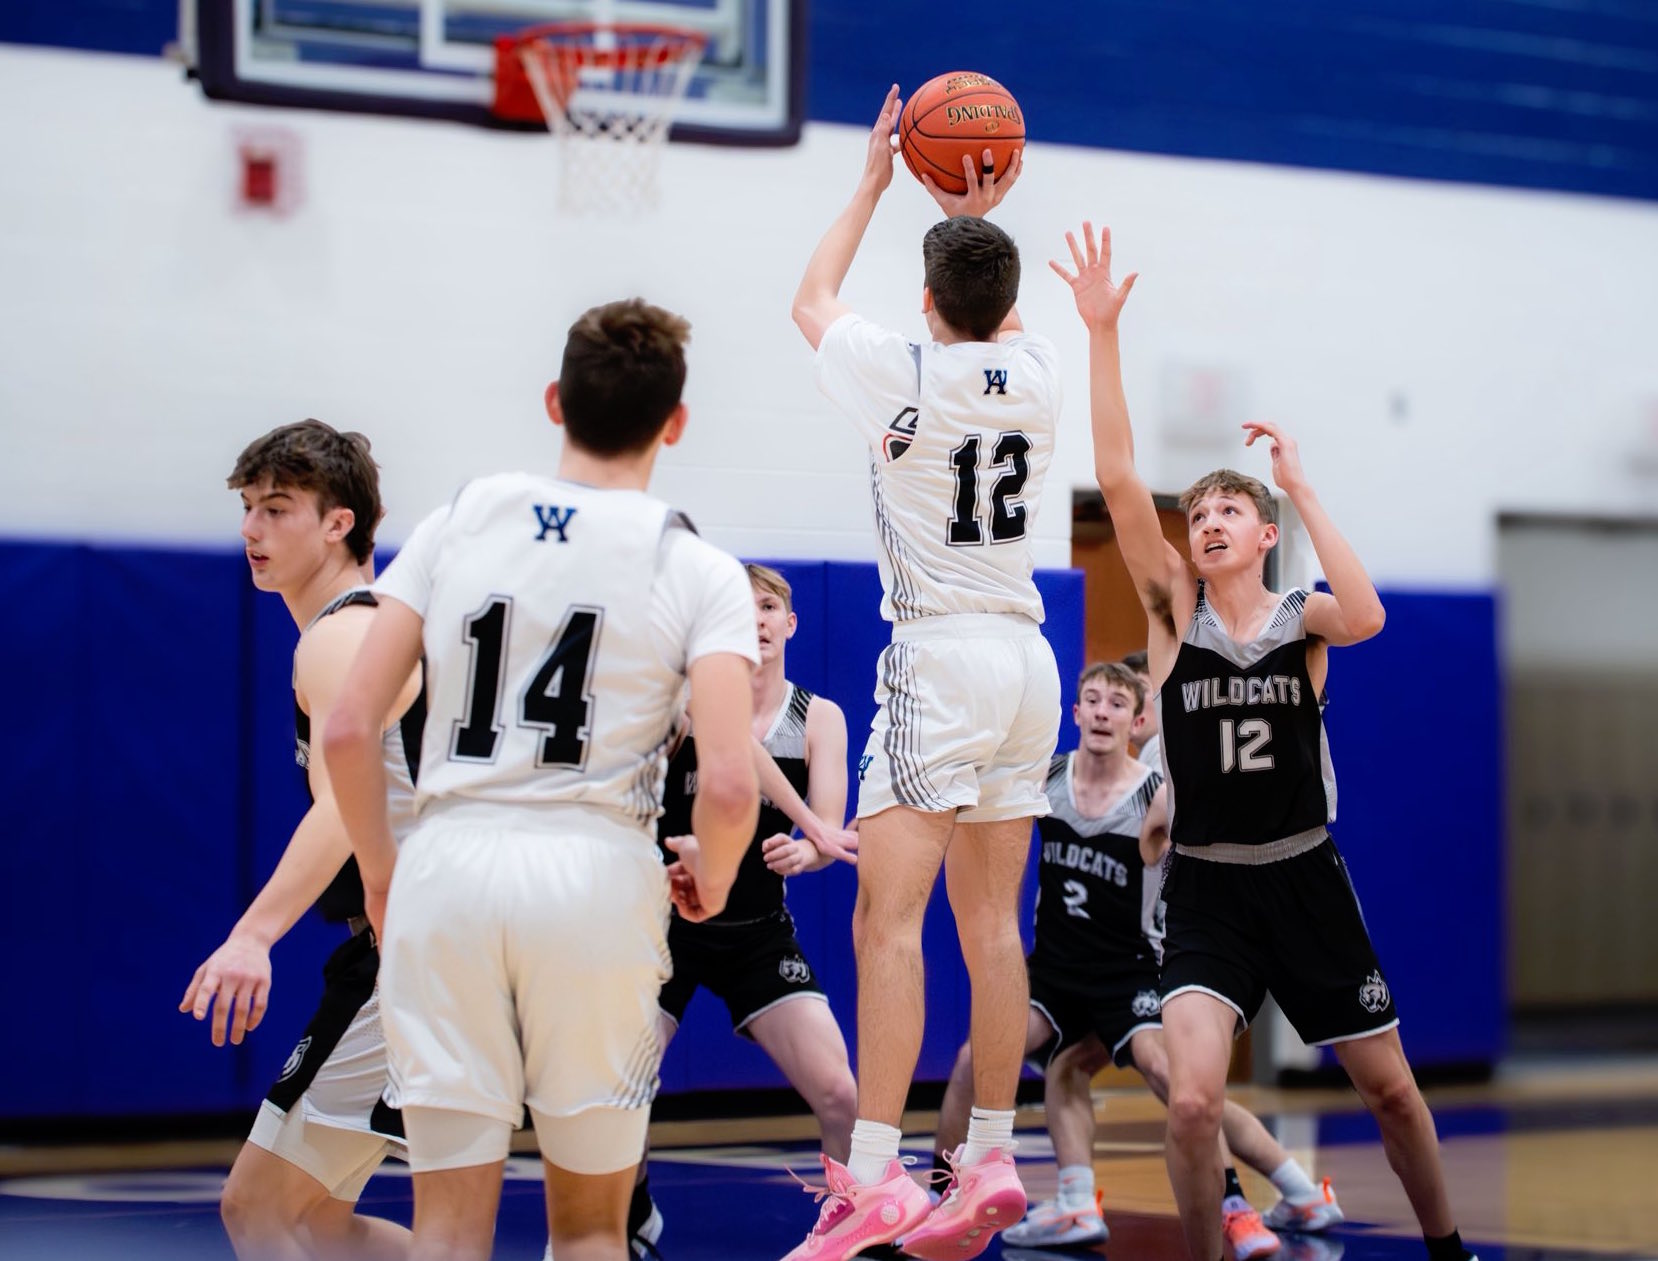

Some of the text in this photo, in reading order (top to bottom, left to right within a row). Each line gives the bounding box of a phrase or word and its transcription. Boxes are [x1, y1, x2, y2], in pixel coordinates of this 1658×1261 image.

[946, 430, 1033, 546] 12
[448, 594, 605, 773] 14
[1181, 675, 1301, 712] WILDCATS
[1219, 718, 1275, 773] 12
[1062, 879, 1091, 920] 2
